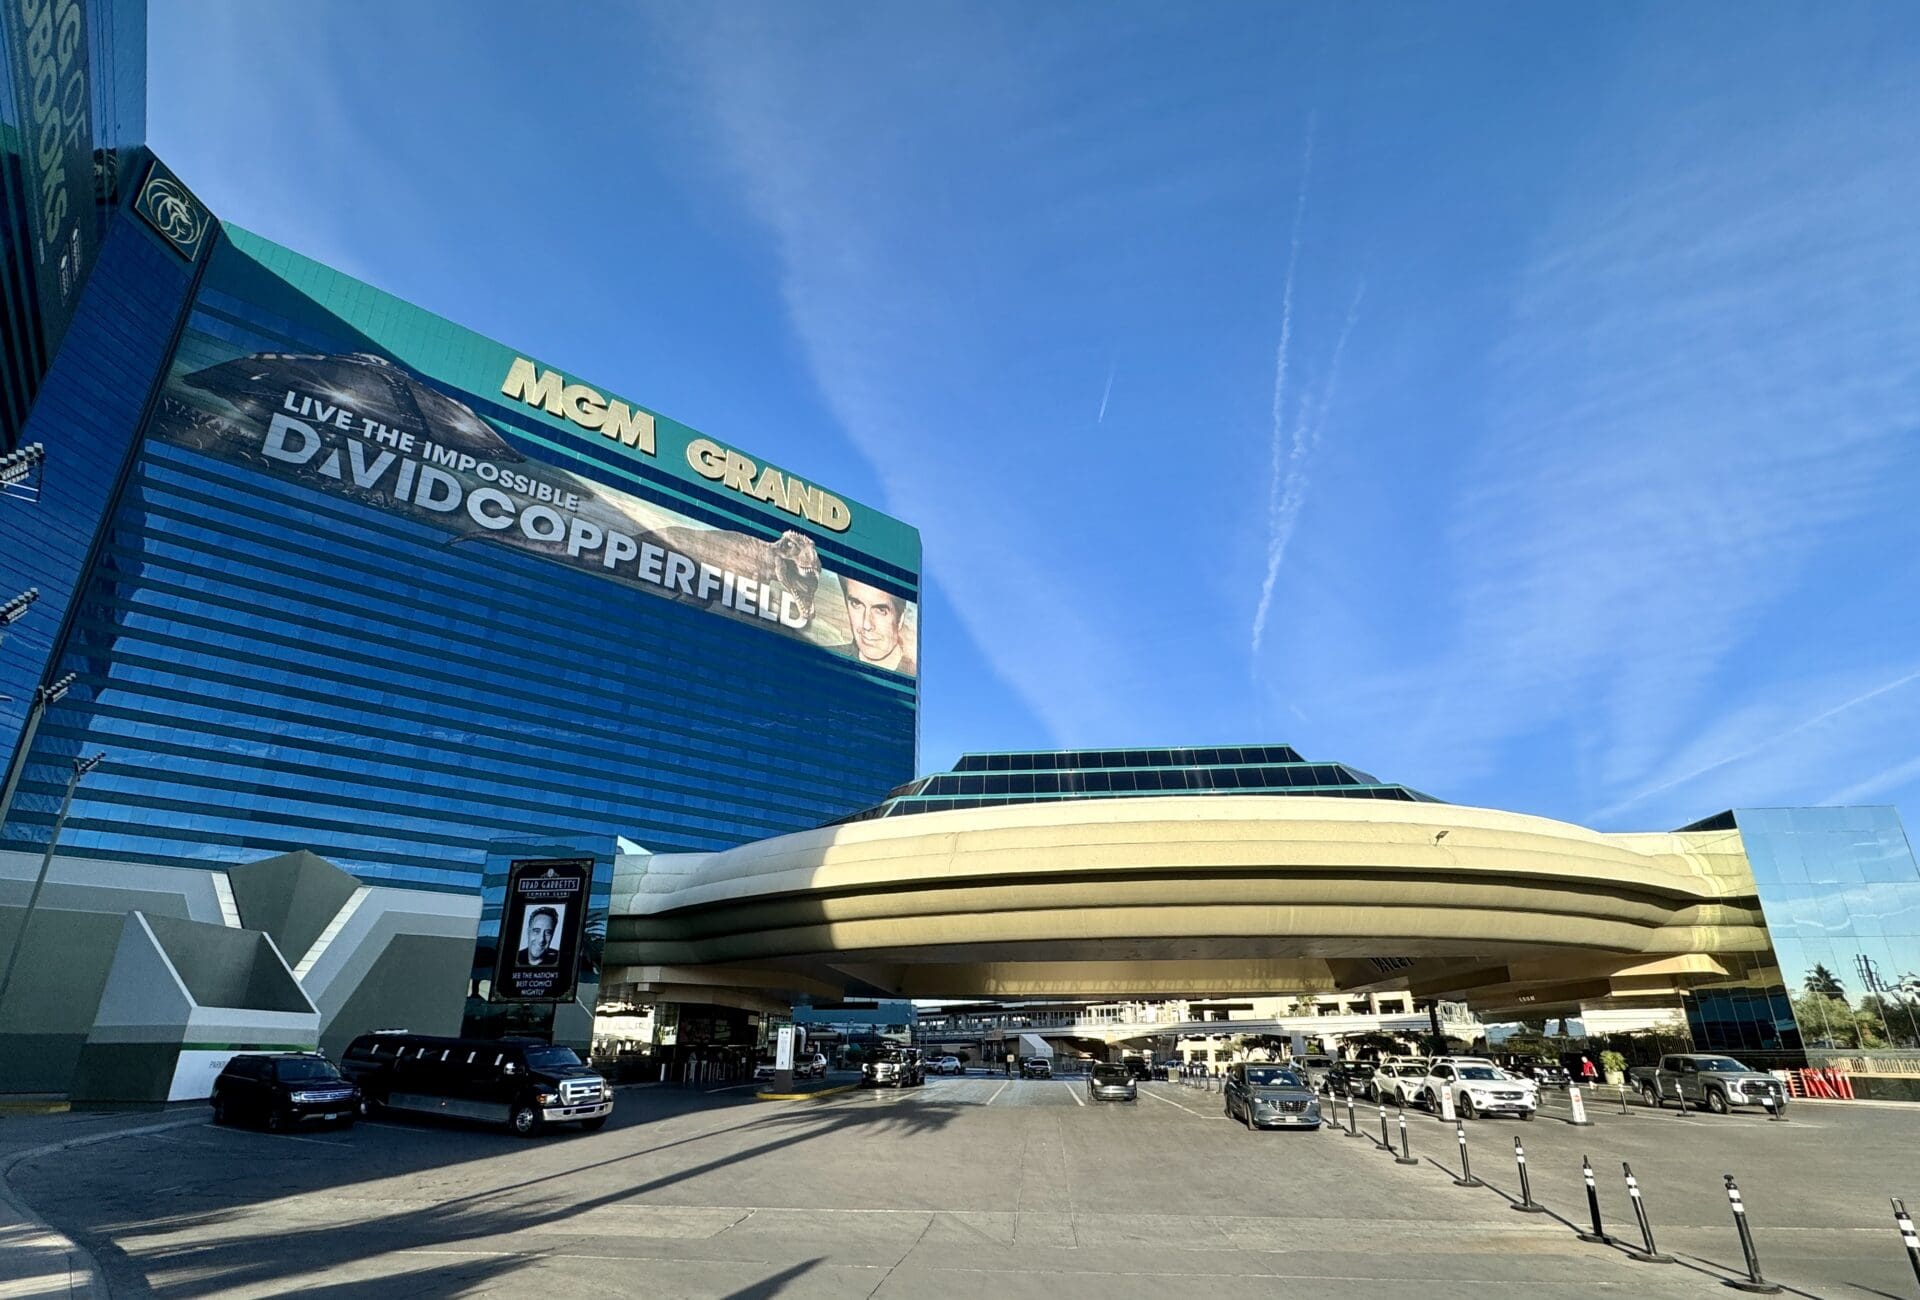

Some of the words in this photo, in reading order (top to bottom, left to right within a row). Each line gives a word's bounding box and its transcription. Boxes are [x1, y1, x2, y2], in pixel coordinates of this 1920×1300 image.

[63, 69, 87, 149] OF
[283, 390, 353, 431] LIVE
[362, 416, 416, 453] THE
[422, 441, 579, 512] IMPOSSIBLE
[501, 357, 656, 457] MGM
[686, 438, 851, 533] GRAND
[261, 411, 463, 513] DAVID
[466, 487, 810, 629] COPPERFIELD
